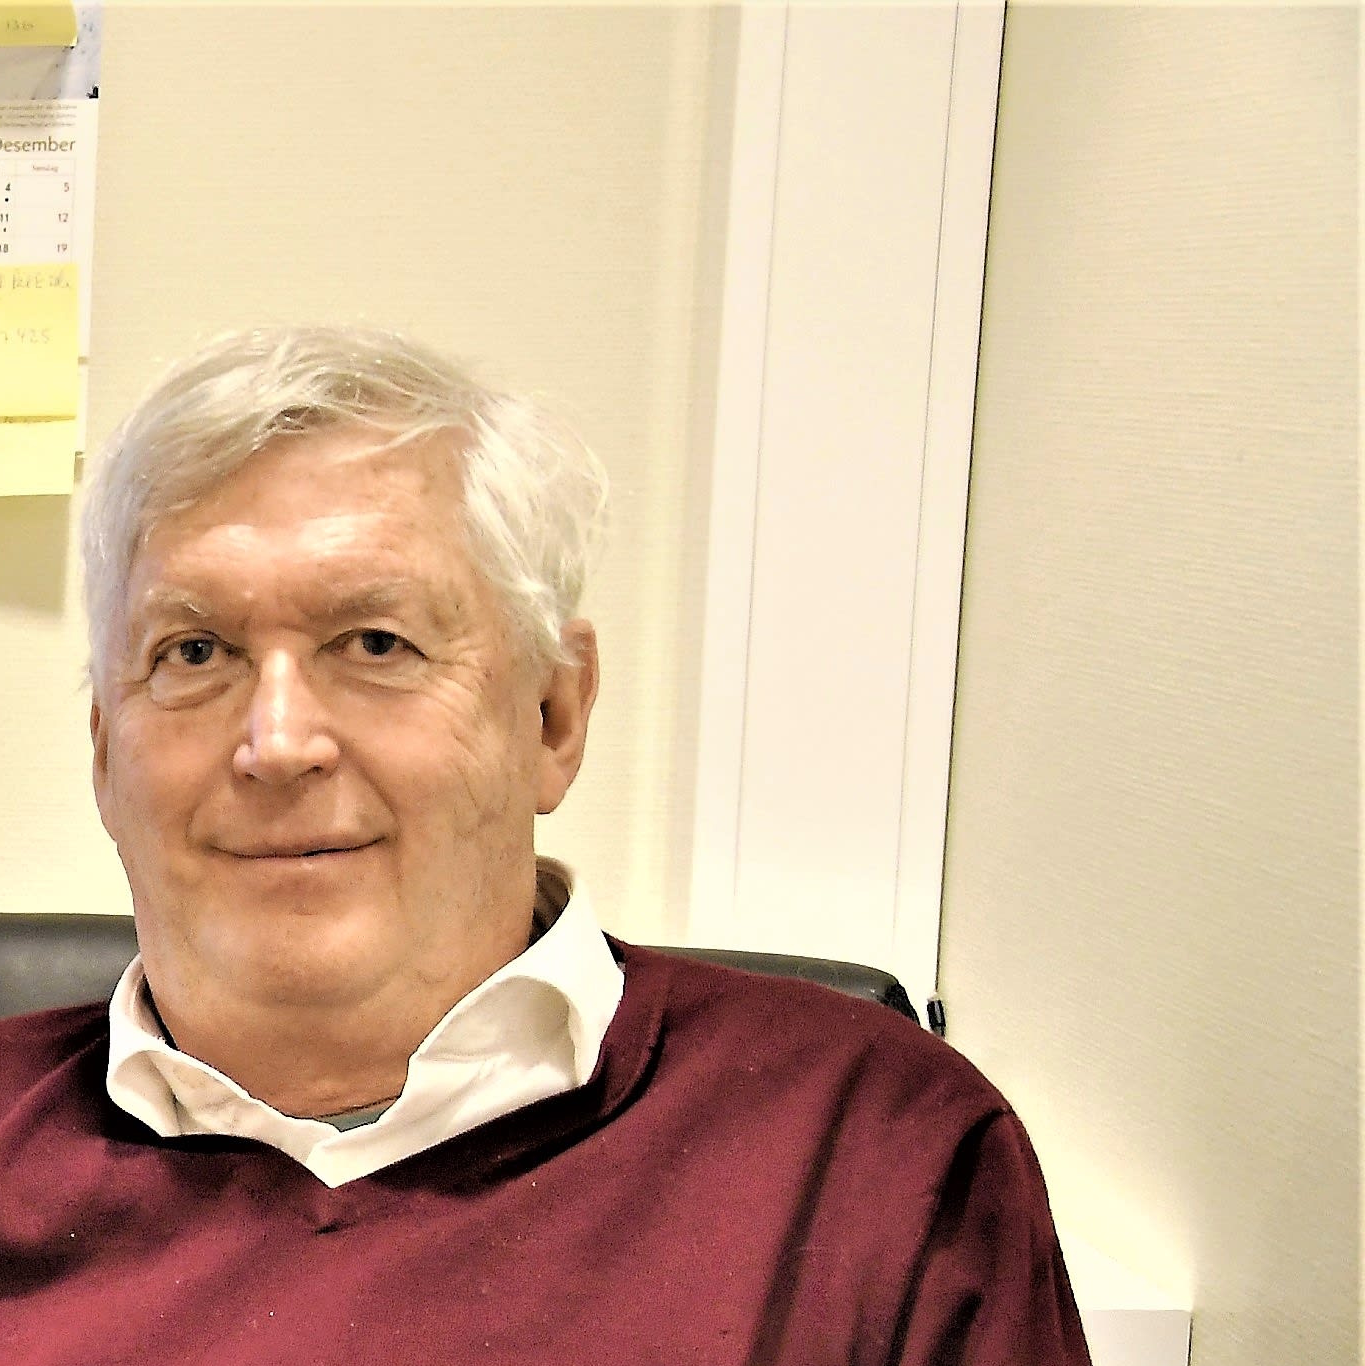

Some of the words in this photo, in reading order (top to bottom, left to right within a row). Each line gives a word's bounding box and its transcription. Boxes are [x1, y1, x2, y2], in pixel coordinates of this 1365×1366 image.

[5, 182, 11, 191] 4
[64, 182, 70, 192] 5
[0, 213, 9, 223] 11
[58, 213, 69, 223] 12
[57, 243, 68, 253] 19
